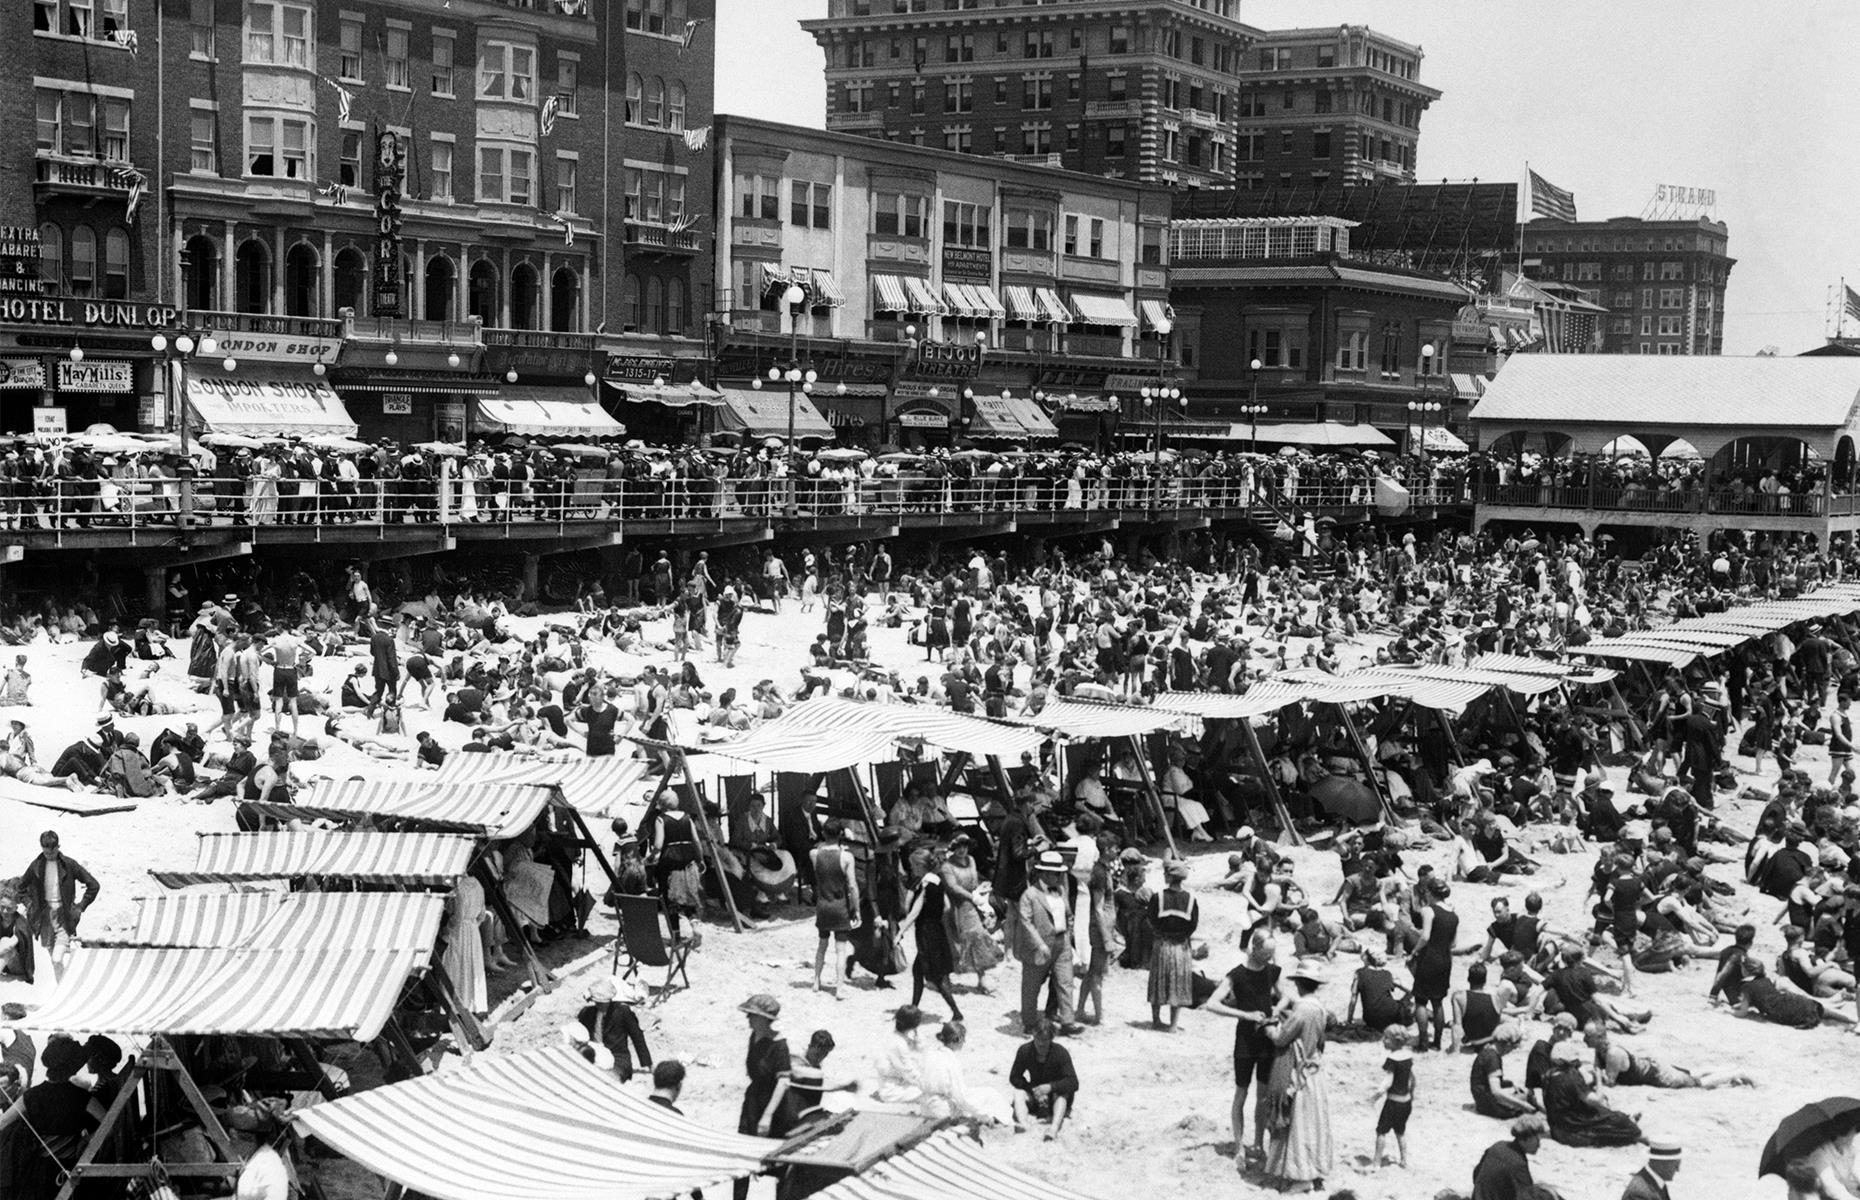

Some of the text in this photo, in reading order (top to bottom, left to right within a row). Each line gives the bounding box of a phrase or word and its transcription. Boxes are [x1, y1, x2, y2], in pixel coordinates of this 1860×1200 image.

[1658, 184, 1715, 206] STRAND
[0, 225, 39, 240] EXTRA
[380, 189, 392, 282] CORT
[0, 242, 44, 258] ABARET
[16, 261, 25, 274] &
[0, 299, 176, 326] HOTEL DUNLOP
[216, 339, 331, 356] ONDON SHOP
[925, 345, 977, 361] BIJOU
[62, 364, 88, 386] May
[625, 367, 657, 380] 1315-17
[922, 361, 978, 377] THEATRE
[188, 378, 332, 399] LONDON SHOPS
[226, 402, 311, 416] IMPORTERS
[388, 403, 407, 412] PLAYS
[827, 408, 865, 427] Hires
